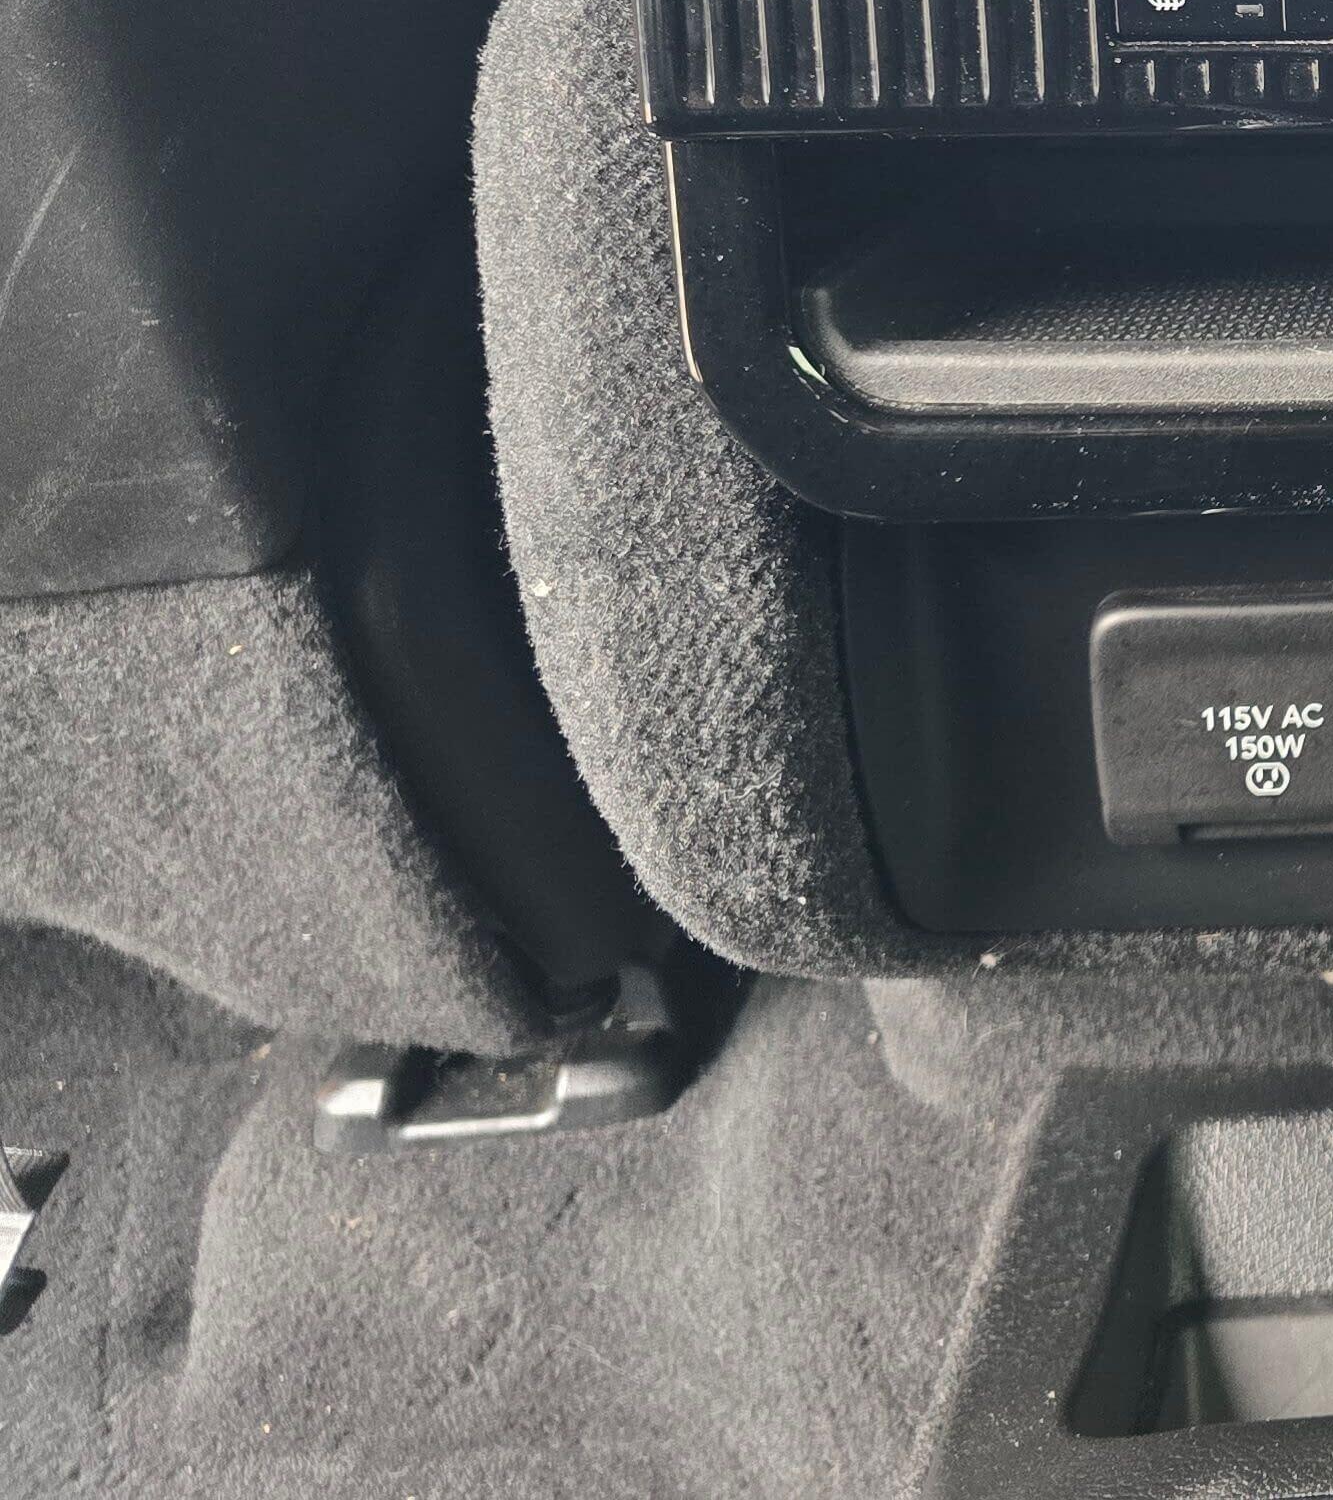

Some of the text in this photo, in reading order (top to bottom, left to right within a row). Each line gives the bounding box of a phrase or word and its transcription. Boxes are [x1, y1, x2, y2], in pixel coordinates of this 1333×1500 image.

[1200, 702, 1325, 732] 115V AC
[1224, 733, 1307, 761] 150W
